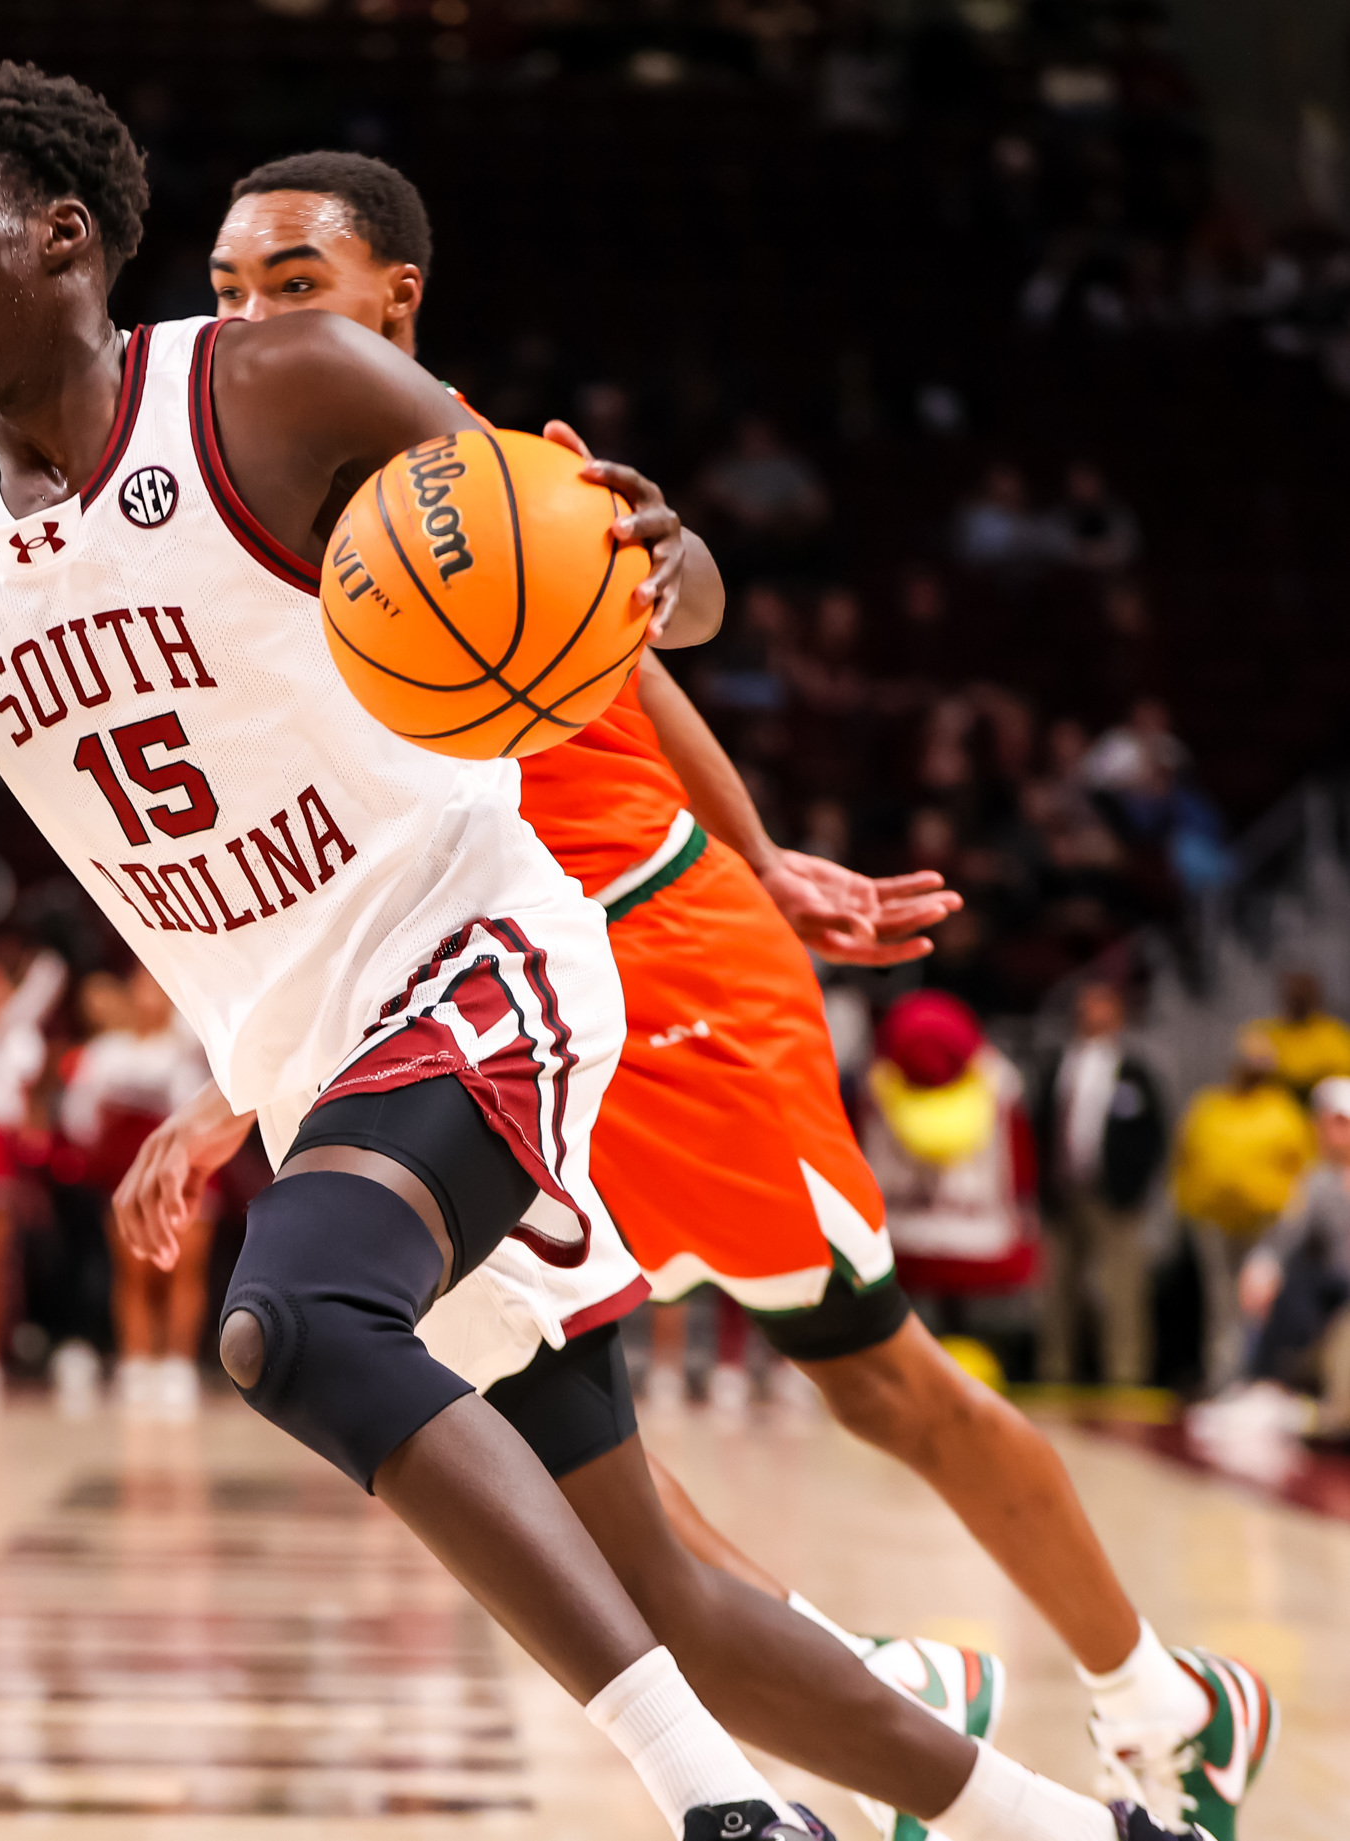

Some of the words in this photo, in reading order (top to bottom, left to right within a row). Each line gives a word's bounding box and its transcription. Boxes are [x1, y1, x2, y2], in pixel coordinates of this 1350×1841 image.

[123, 468, 174, 525] SEC
[73, 710, 219, 847] 15
[90, 784, 357, 934] ROLINA
